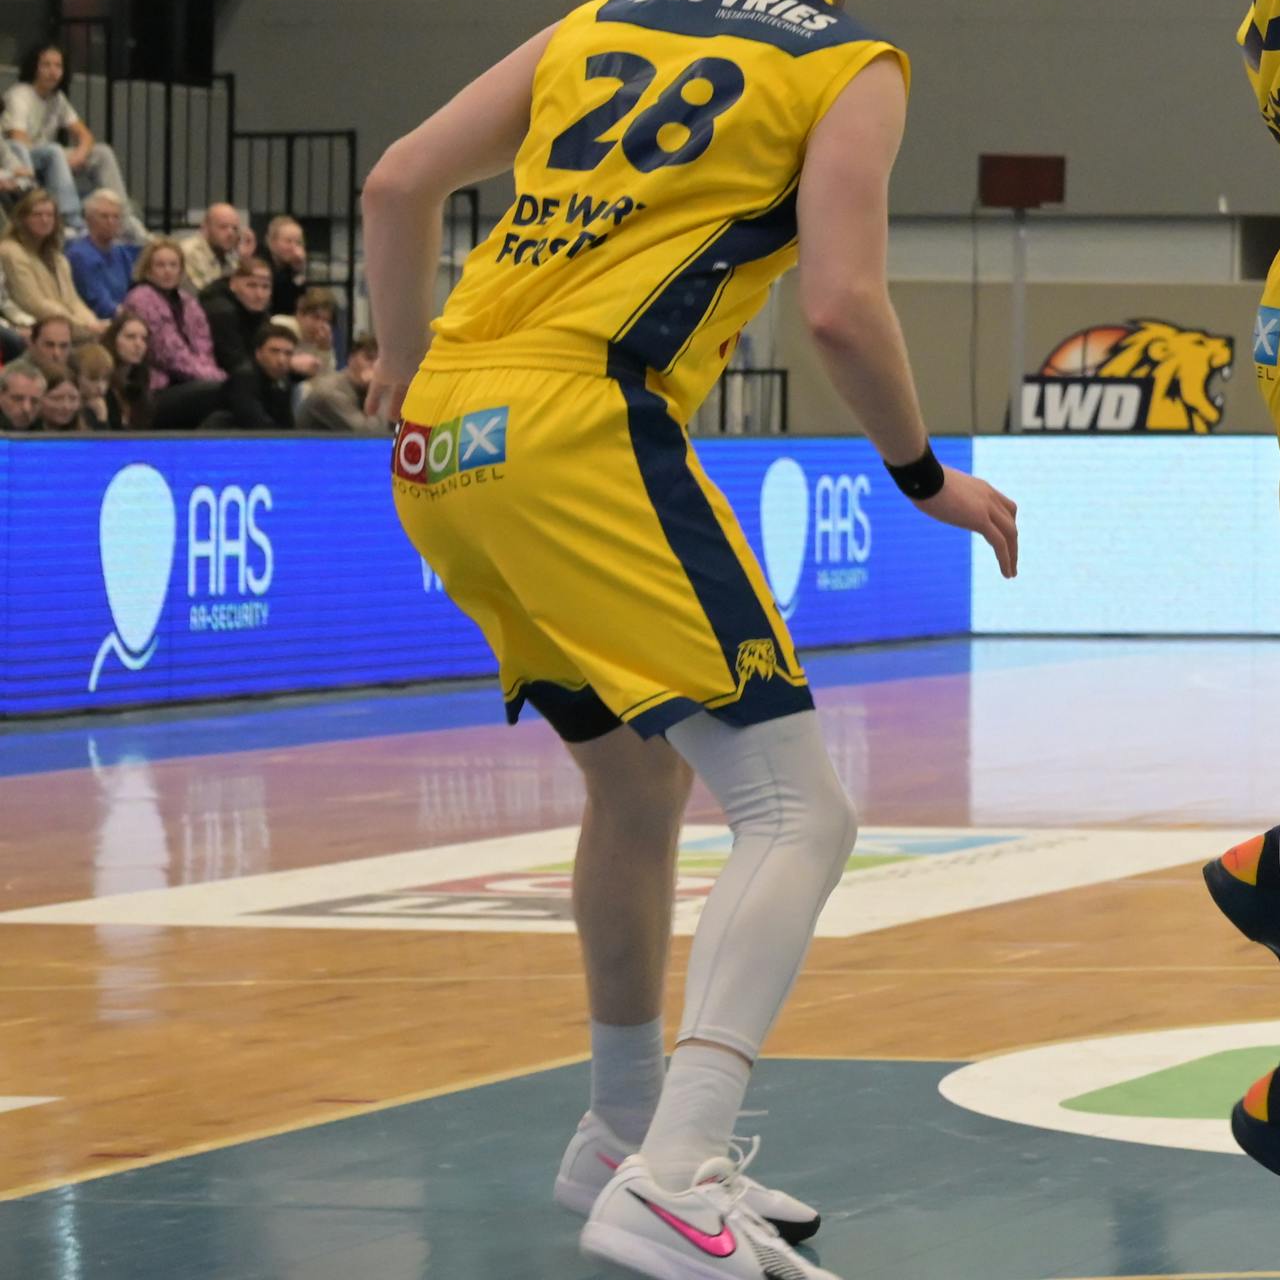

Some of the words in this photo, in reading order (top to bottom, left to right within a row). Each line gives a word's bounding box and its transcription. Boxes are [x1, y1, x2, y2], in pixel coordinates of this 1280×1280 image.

[547, 52, 744, 172] 28
[392, 416, 501, 475] OOX
[1021, 383, 1141, 431] LWD
[188, 484, 273, 597] AAS
[815, 474, 871, 563] AAS
